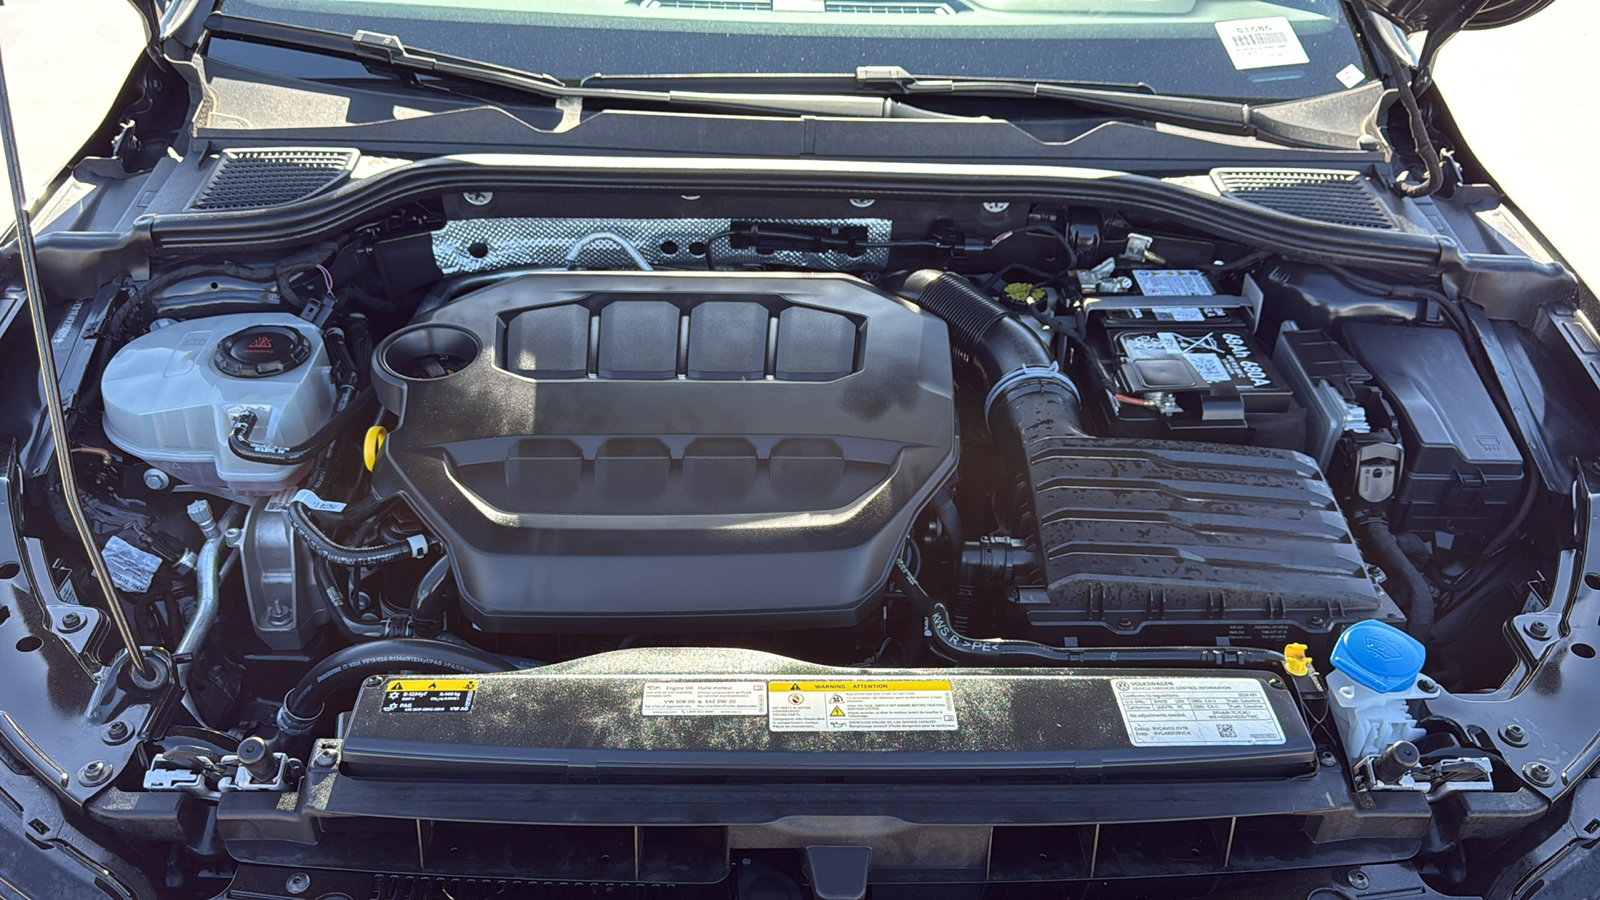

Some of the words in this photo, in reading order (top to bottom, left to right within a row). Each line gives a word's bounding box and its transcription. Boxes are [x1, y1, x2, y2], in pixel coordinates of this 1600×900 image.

[1221, 333, 1251, 359] 68Ah
[1240, 360, 1271, 387] 680A
[931, 612, 950, 637] KWS
[949, 634, 960, 646] R
